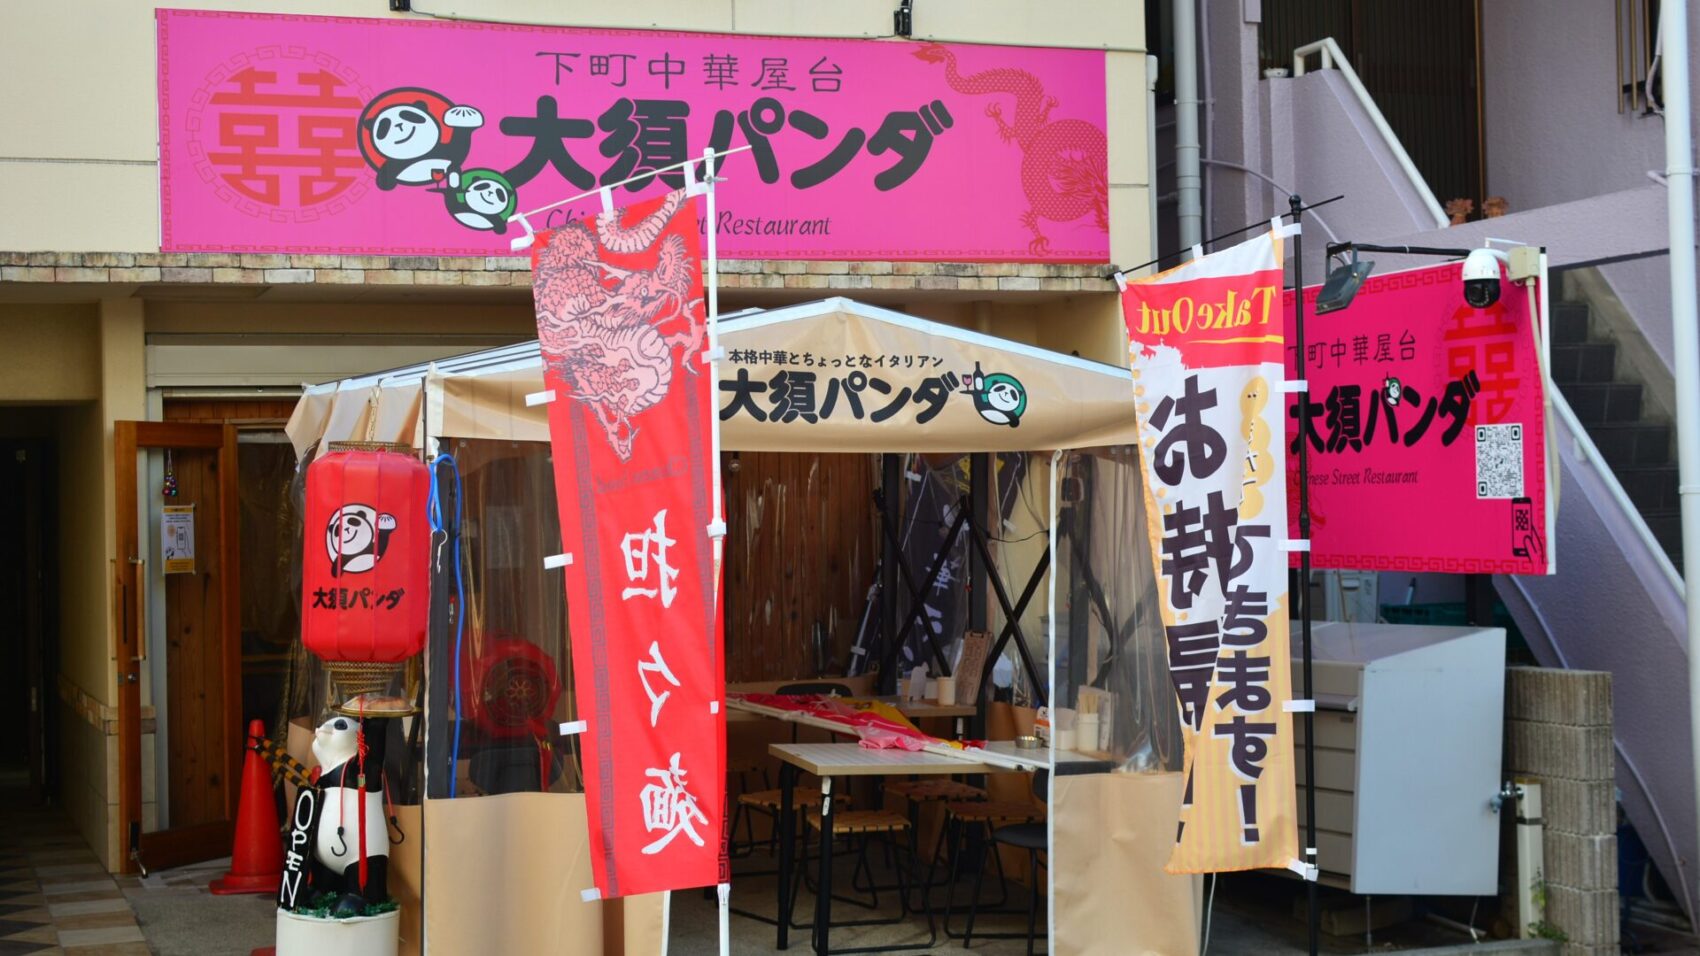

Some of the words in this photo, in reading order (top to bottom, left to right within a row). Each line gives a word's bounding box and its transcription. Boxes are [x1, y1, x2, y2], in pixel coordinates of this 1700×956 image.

[535, 51, 843, 92] 下町中華屋台
[499, 94, 954, 192] 大須パンダ
[716, 210, 832, 235] Restaurant
[728, 348, 944, 368] 本格中華とちょっとなイタリアン
[718, 367, 959, 424] 大須パンダ
[1332, 468, 1361, 485] Street
[1363, 467, 1418, 484] Restaurant
[280, 790, 314, 907] OPEN
